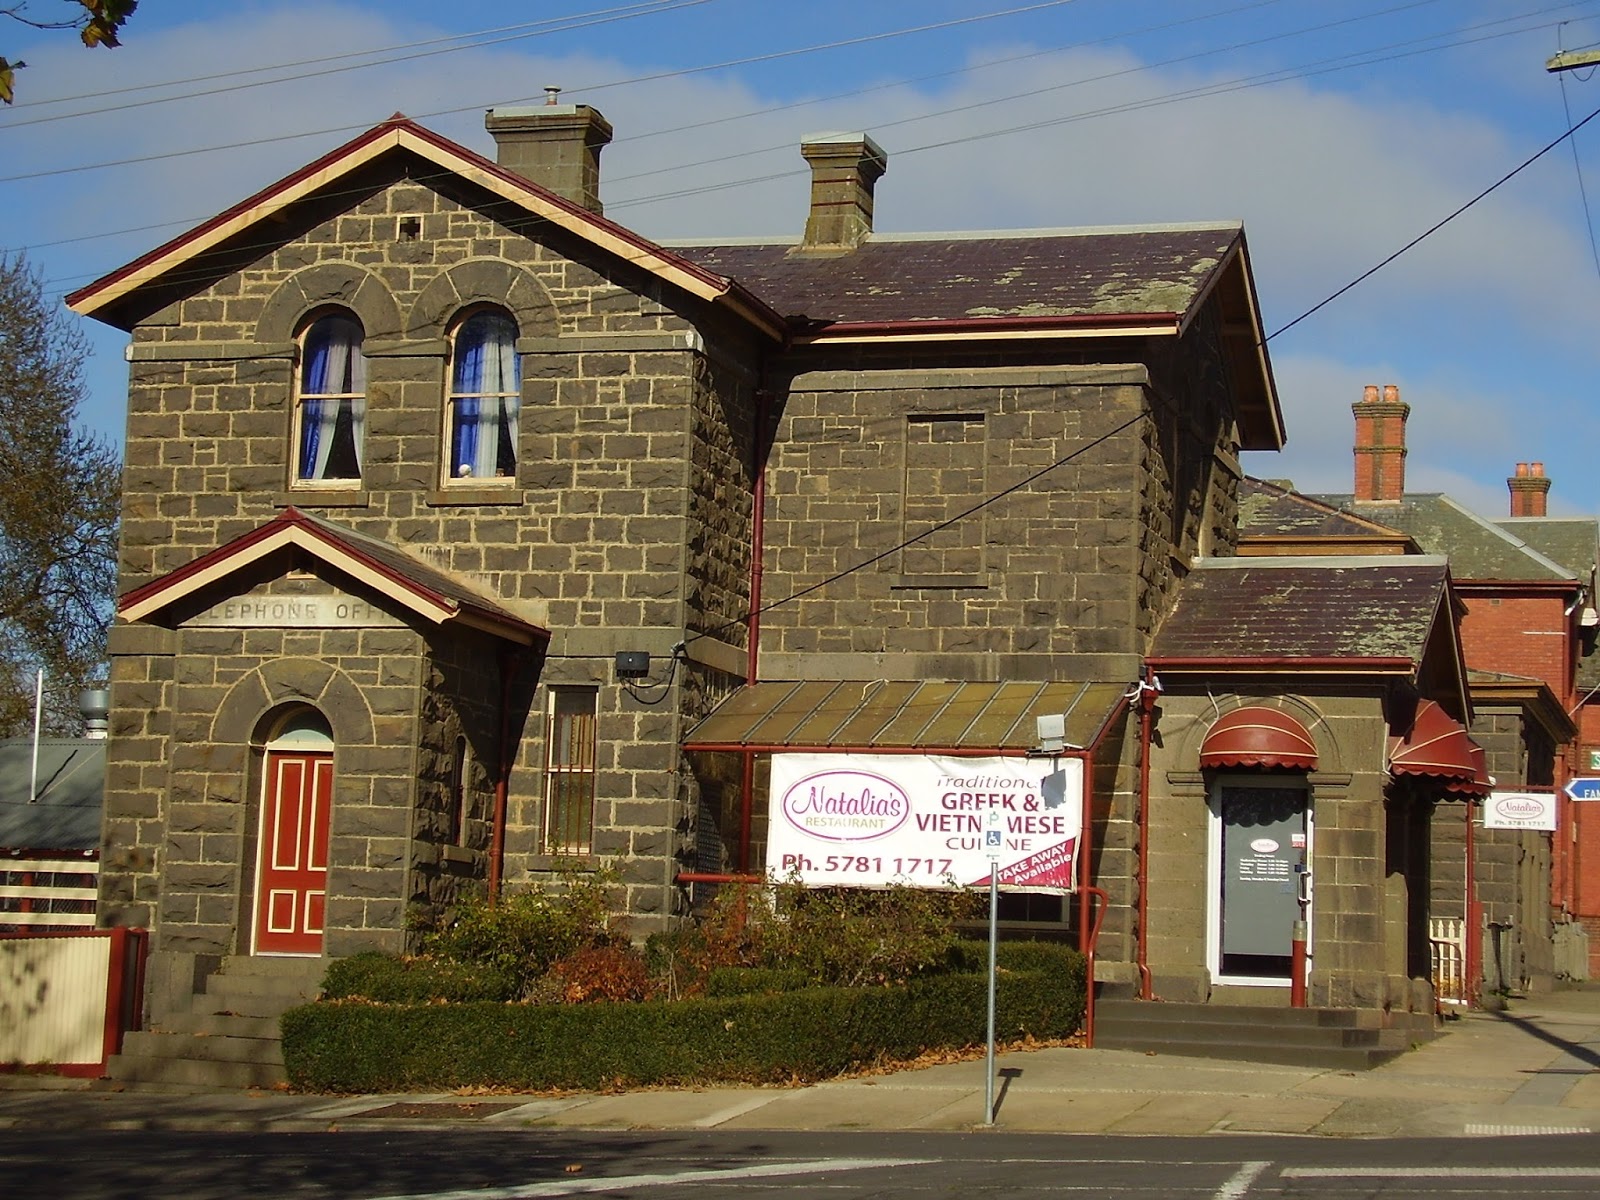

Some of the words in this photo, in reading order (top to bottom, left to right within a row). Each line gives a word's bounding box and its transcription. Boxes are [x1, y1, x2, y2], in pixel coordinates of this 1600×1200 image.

[791, 785, 901, 817] Natalia's
[1023, 793, 1039, 812] &
[805, 816, 886, 829] RESTAURANT
[916, 813, 1065, 835] VIETNMESE
[946, 837, 1032, 851] CUINE
[782, 853, 819, 872] Ph.
[825, 856, 882, 873] 5781
[893, 858, 953, 875] 1717
[997, 859, 1030, 882] TAKE
[1030, 842, 1068, 867] AWAY
[1014, 853, 1072, 885] Available
